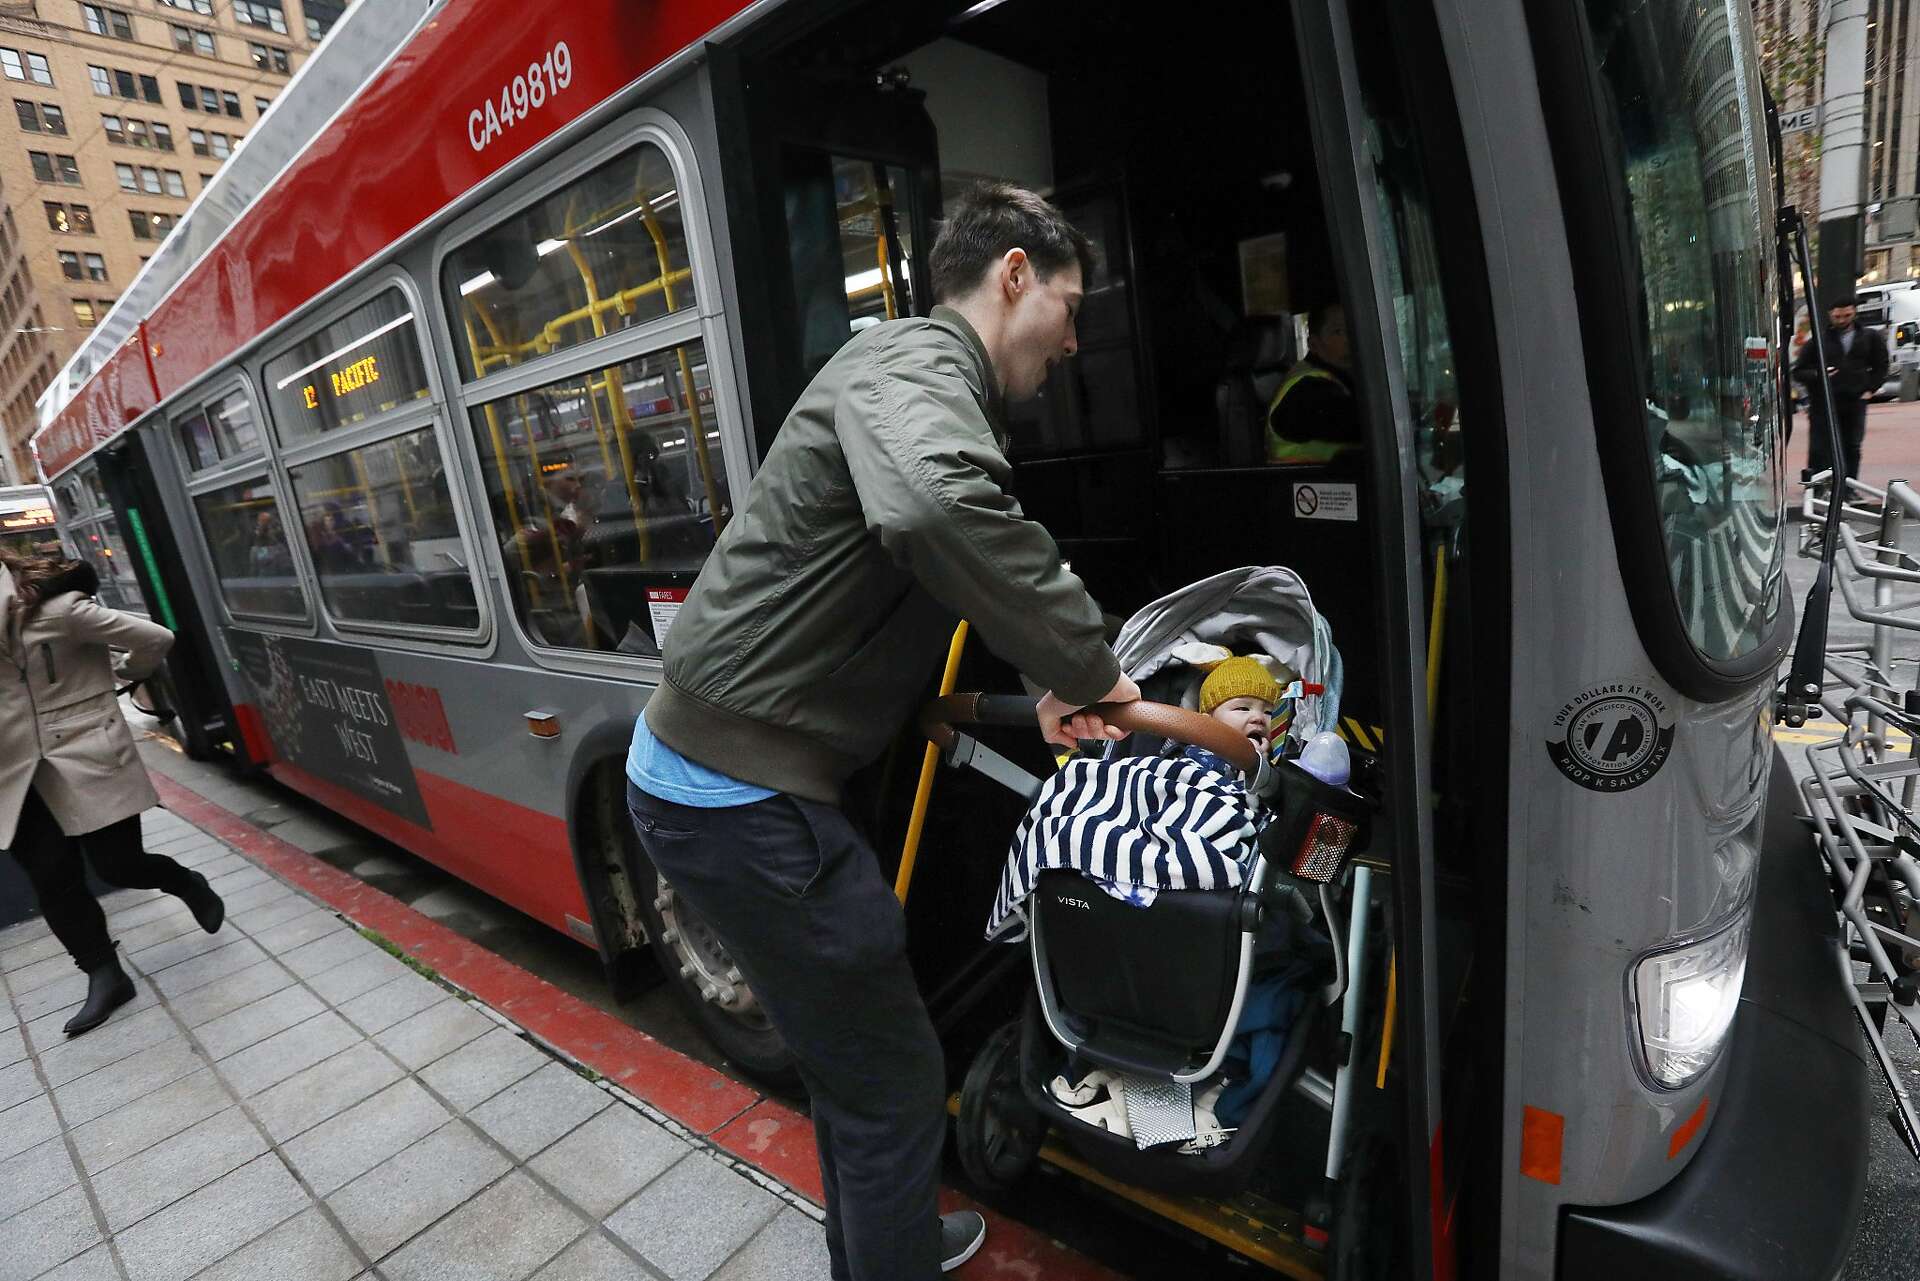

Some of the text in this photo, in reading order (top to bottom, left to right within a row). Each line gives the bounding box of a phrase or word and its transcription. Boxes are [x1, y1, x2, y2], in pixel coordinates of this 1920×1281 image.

[468, 41, 572, 152] CA49819
[331, 356, 380, 397] PACIFIC
[299, 675, 336, 710] EAST
[329, 680, 389, 727] MEETS
[1552, 684, 1667, 728] YOUR DOLLARS AT WORK
[1586, 703, 1626, 720] FRANCISCO
[1627, 705, 1649, 722] COUNTY
[333, 720, 379, 765] WEST
[1575, 729, 1652, 769] TRANSPORTATION AUTHORITY
[1560, 745, 1667, 788] PROP K SALES TAX
[1057, 896, 1090, 910] VISTA
